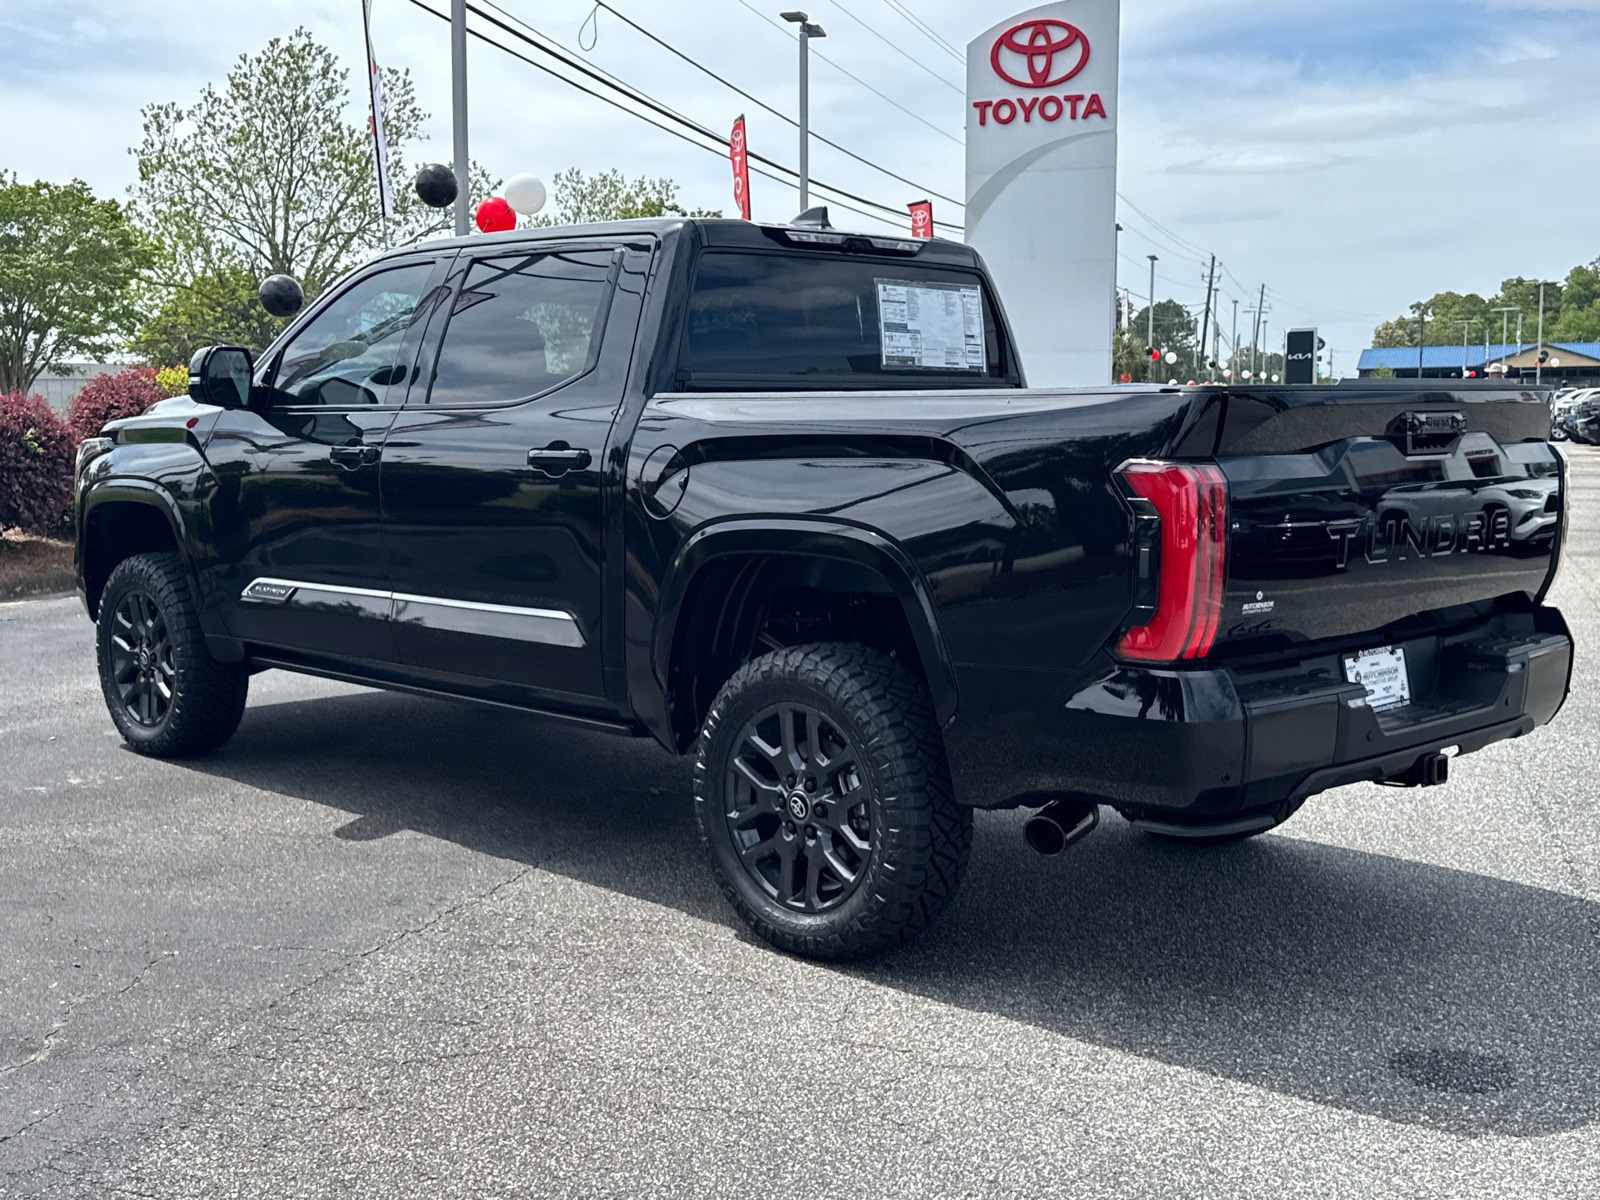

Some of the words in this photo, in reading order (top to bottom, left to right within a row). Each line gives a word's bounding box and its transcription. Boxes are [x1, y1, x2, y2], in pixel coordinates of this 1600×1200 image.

[973, 94, 1107, 125] TOYOTA
[1326, 508, 1512, 568] TUNDRA
[255, 585, 286, 595] PLATINUM
